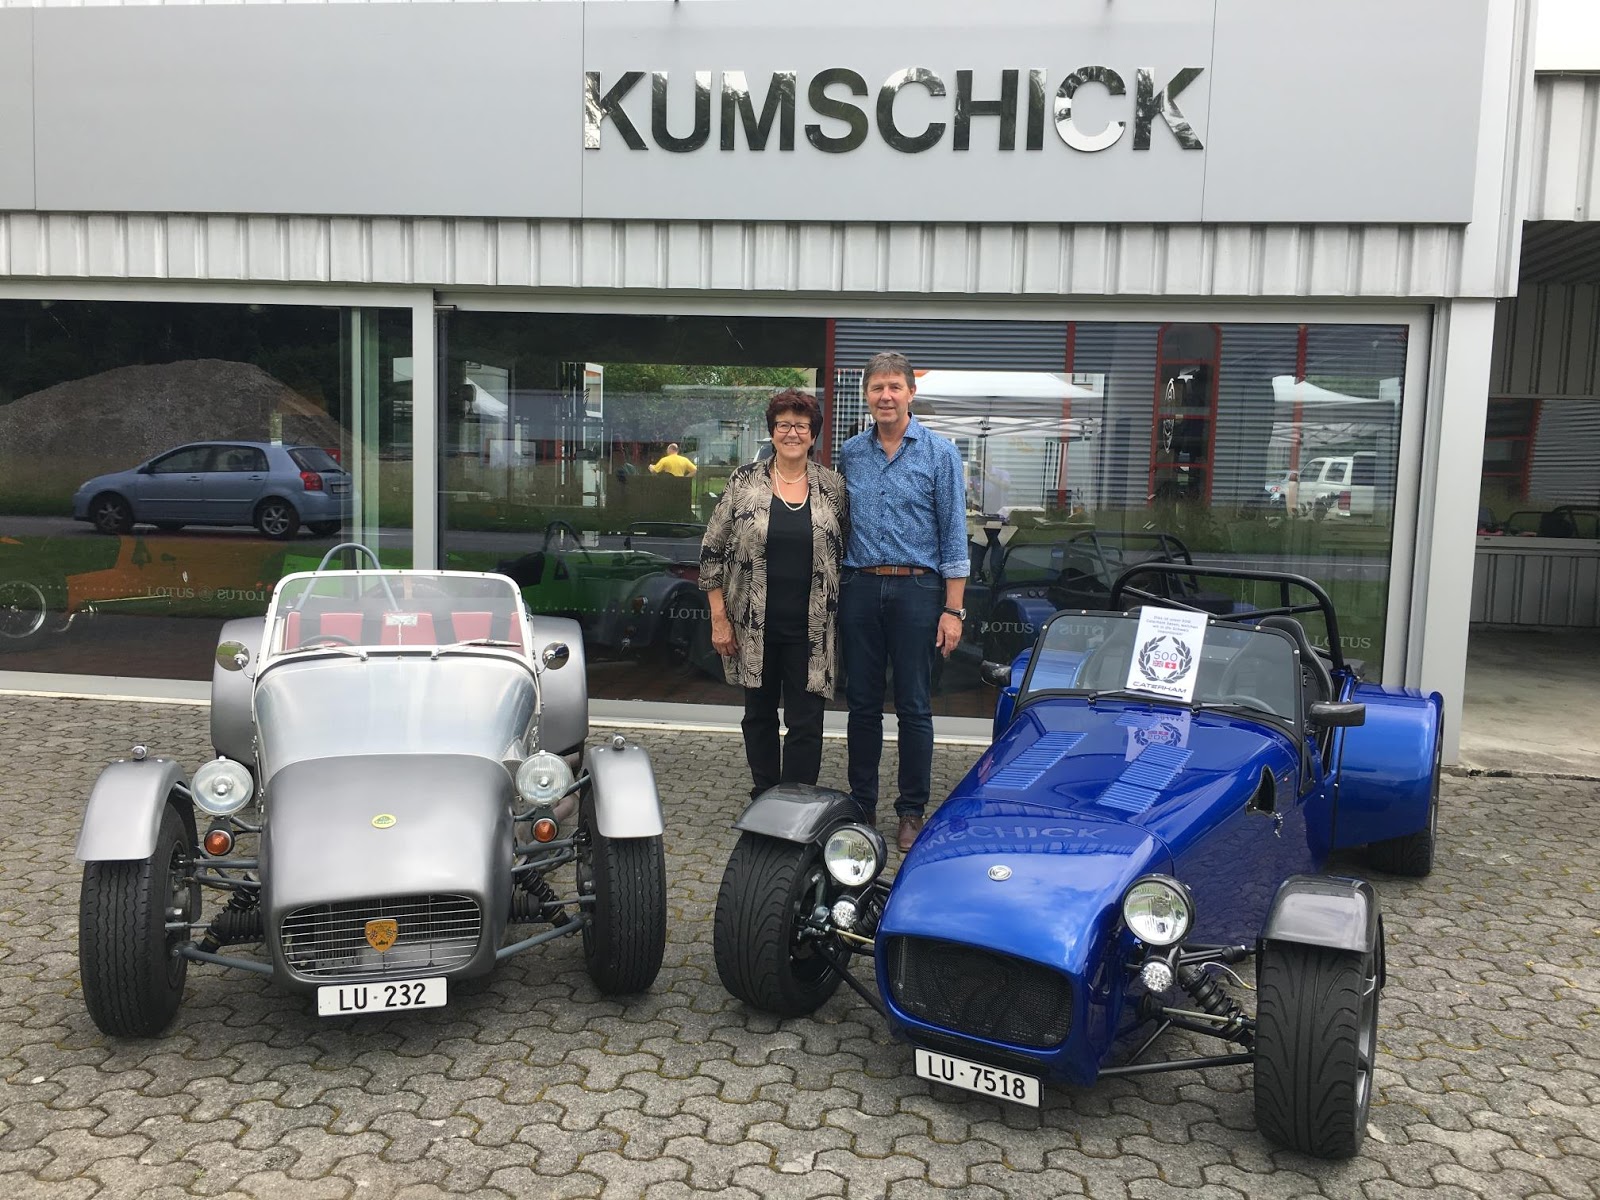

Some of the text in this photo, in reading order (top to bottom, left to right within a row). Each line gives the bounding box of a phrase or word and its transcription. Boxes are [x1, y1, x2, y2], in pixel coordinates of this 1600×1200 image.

[584, 65, 1205, 153] KUMSCHICK
[147, 586, 194, 598] LOTUS
[668, 608, 711, 620] LOTU
[981, 621, 1035, 634] LOTUS
[1153, 650, 1178, 662] 500
[1132, 681, 1187, 693] CATERHAM
